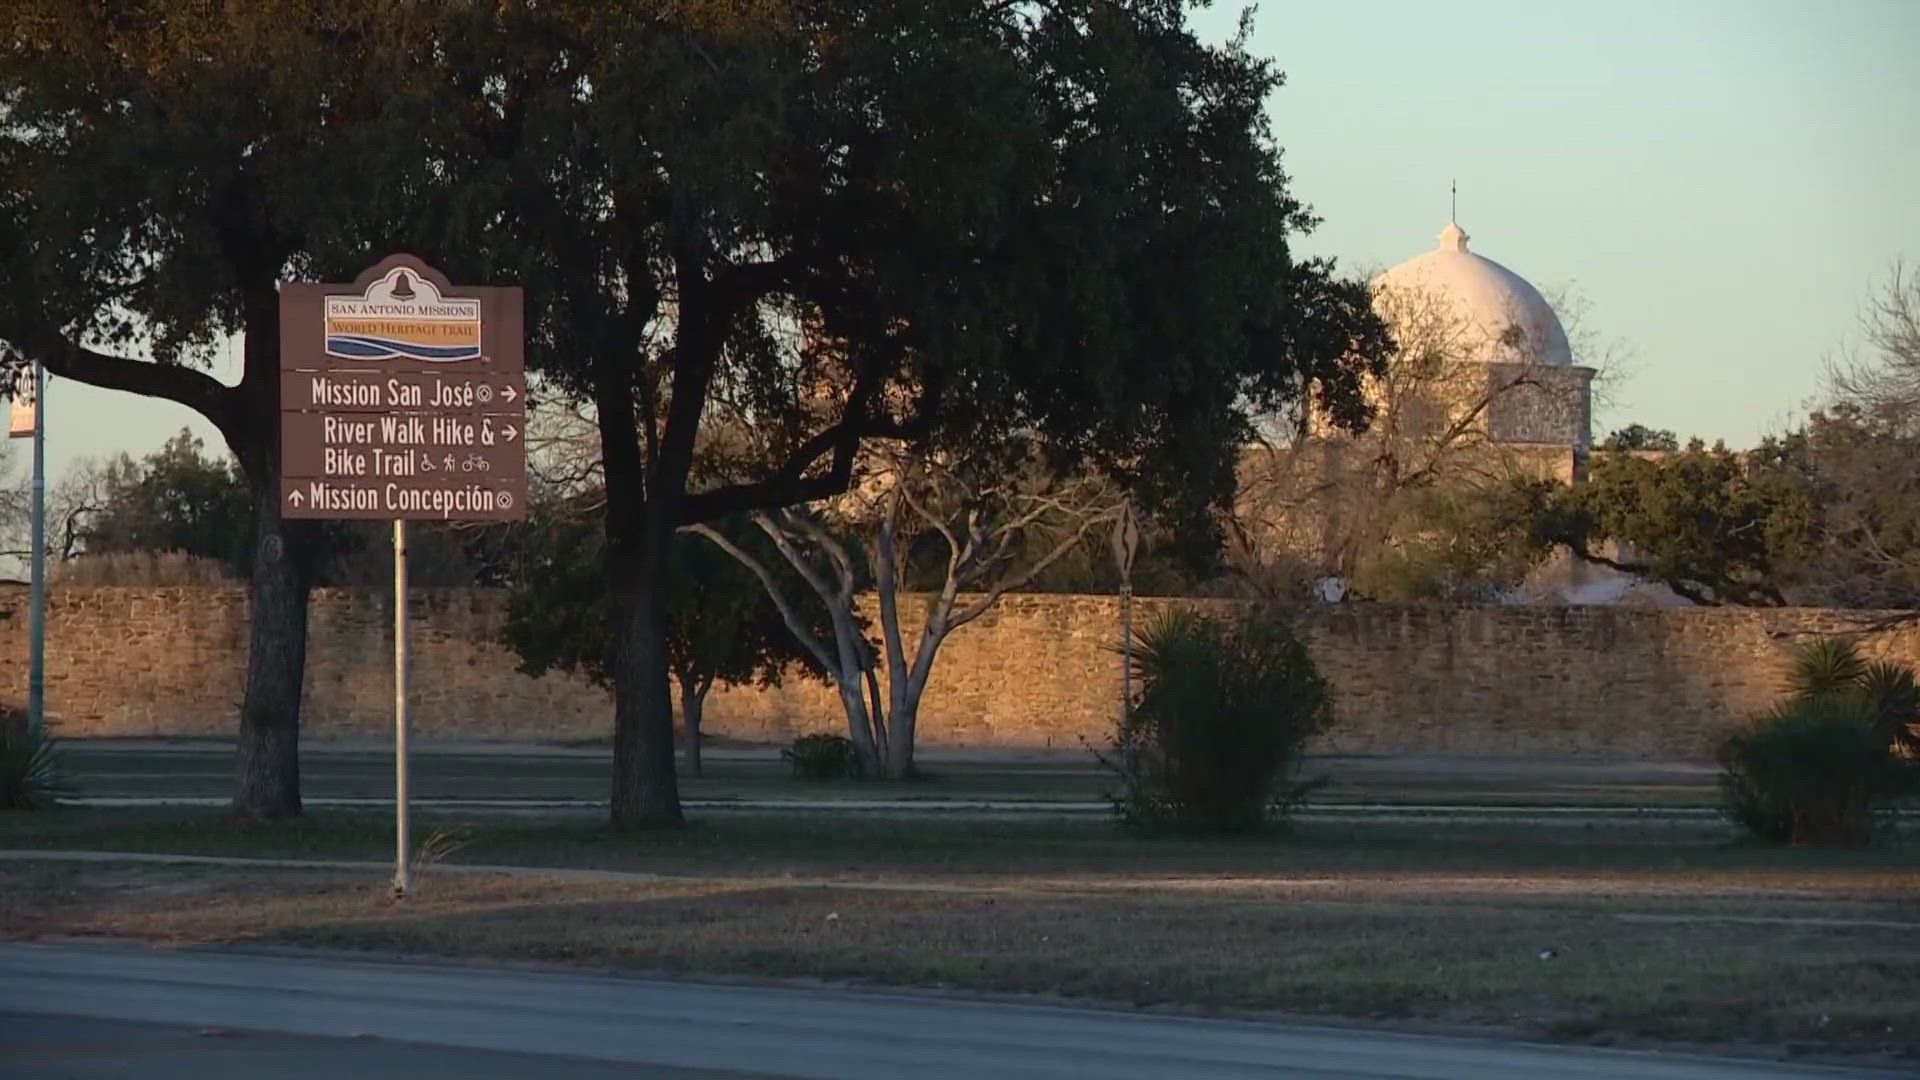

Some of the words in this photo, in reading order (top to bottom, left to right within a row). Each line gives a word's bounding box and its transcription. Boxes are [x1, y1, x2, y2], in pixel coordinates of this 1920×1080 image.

[331, 304, 357, 315] SAN
[361, 304, 415, 315] ANTONIO
[418, 305, 474, 317] MISSIONS
[312, 377, 380, 406] Mission
[388, 379, 421, 406] San
[430, 379, 473, 406] José
[324, 417, 374, 444] River
[381, 418, 425, 444] Walk
[433, 418, 474, 445] Hike
[481, 418, 494, 446] &
[325, 449, 365, 475] Bike
[373, 449, 414, 476] Trail
[310, 482, 378, 510] Mission
[386, 483, 493, 518] Concepción
